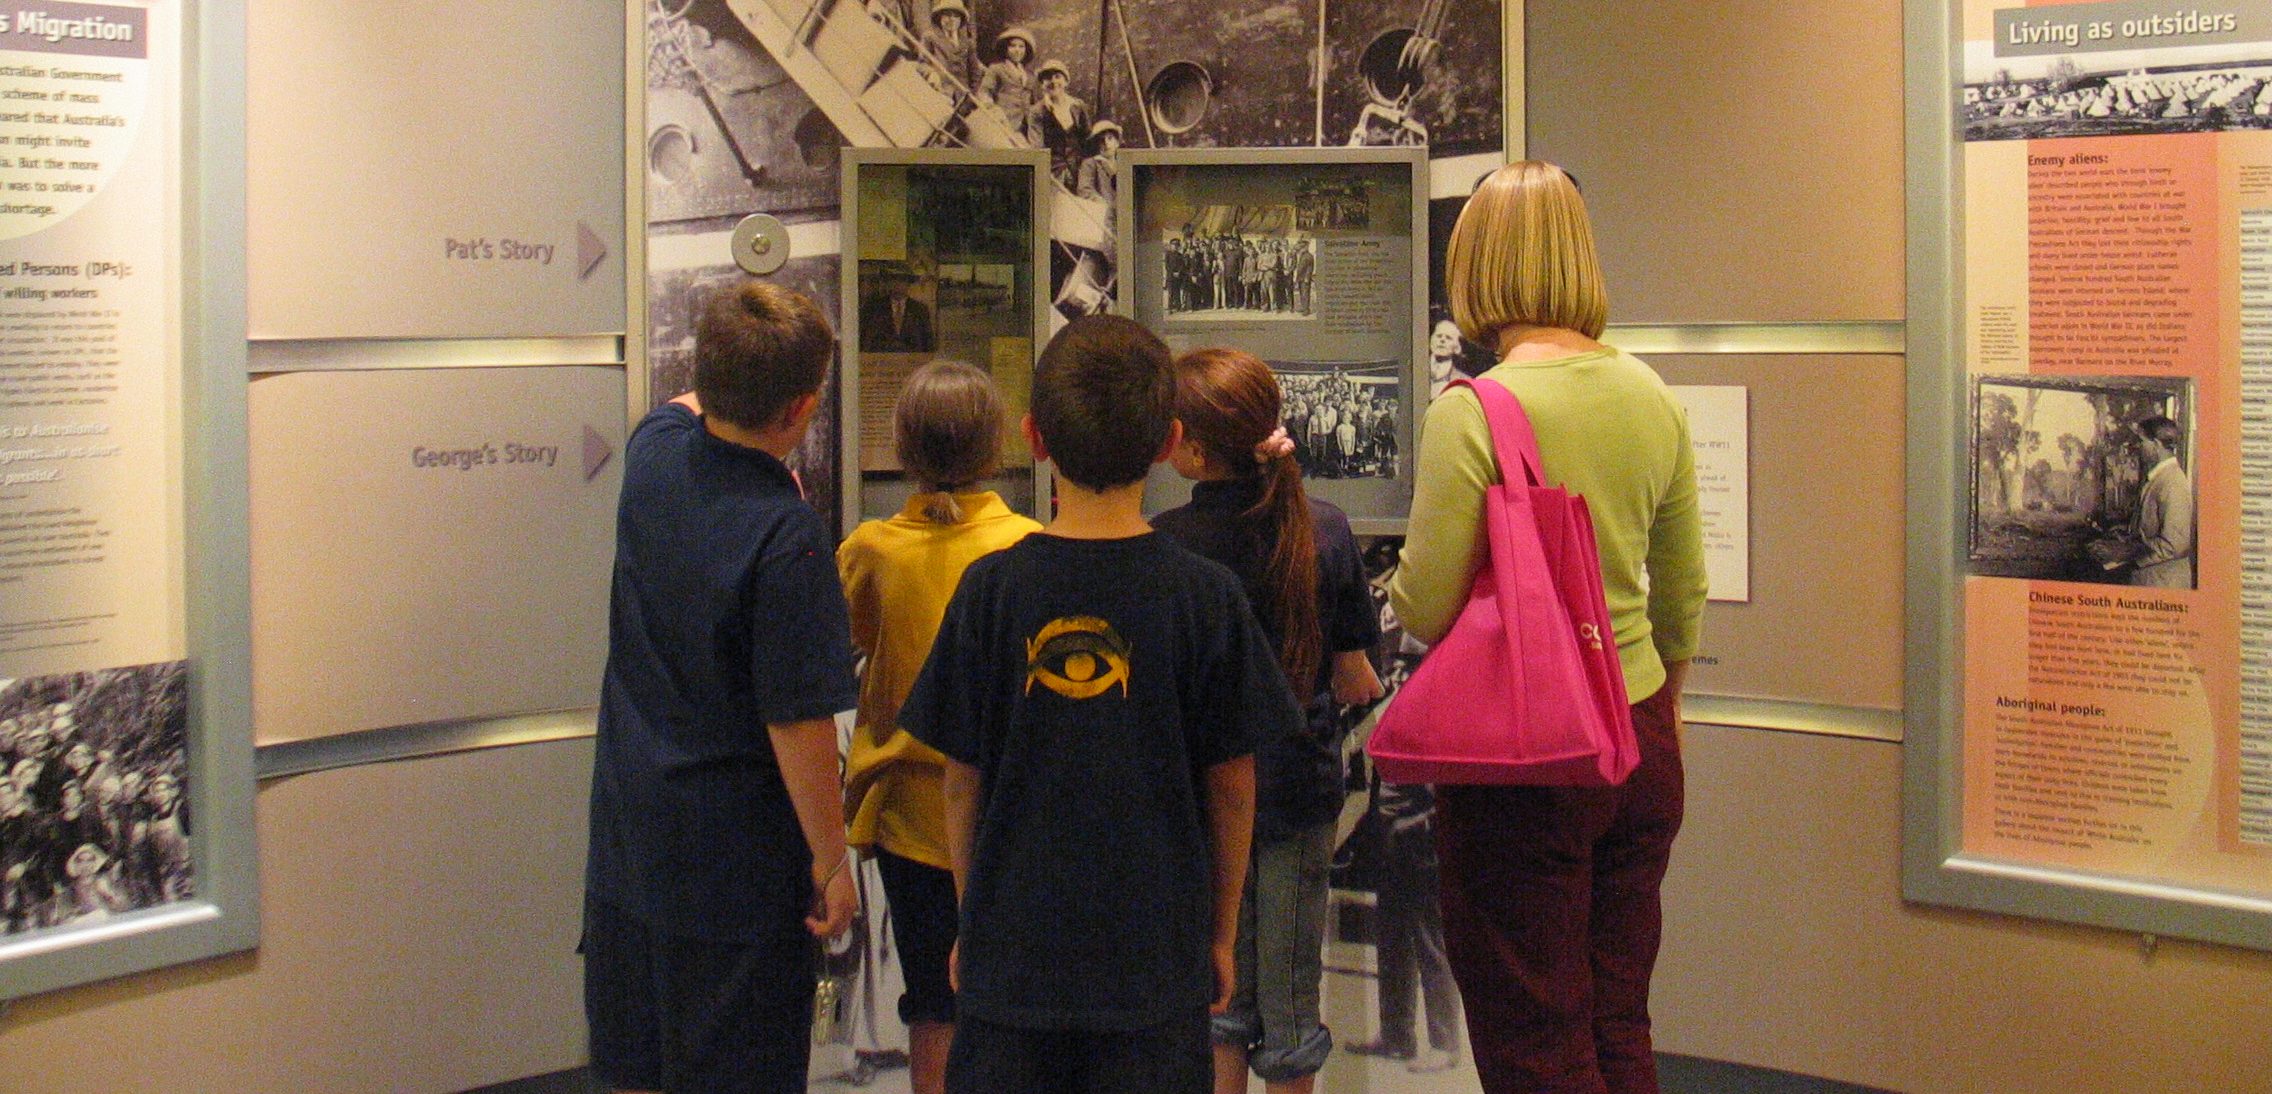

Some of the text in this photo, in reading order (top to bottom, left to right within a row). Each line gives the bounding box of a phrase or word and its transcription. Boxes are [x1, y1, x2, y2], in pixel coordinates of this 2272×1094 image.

[17, 11, 134, 43] Migration
[2009, 11, 2237, 48] Living as outsiders
[50, 67, 123, 83] Government
[52, 91, 66, 102] of
[34, 113, 59, 124] that
[56, 136, 91, 148] invite
[19, 157, 40, 169] But
[44, 159, 64, 169] the
[2028, 153, 2109, 168] Enemy aliens:
[35, 182, 47, 192] to
[445, 238, 555, 265] Pat's Story
[21, 262, 79, 277] Persons
[4, 287, 99, 302] willing workers
[412, 443, 558, 470] George's Story
[2029, 591, 2073, 606] Chinese
[2078, 594, 2112, 608] South
[2116, 598, 2189, 614] Australians:
[1996, 696, 2105, 718] Aboriginal people:
